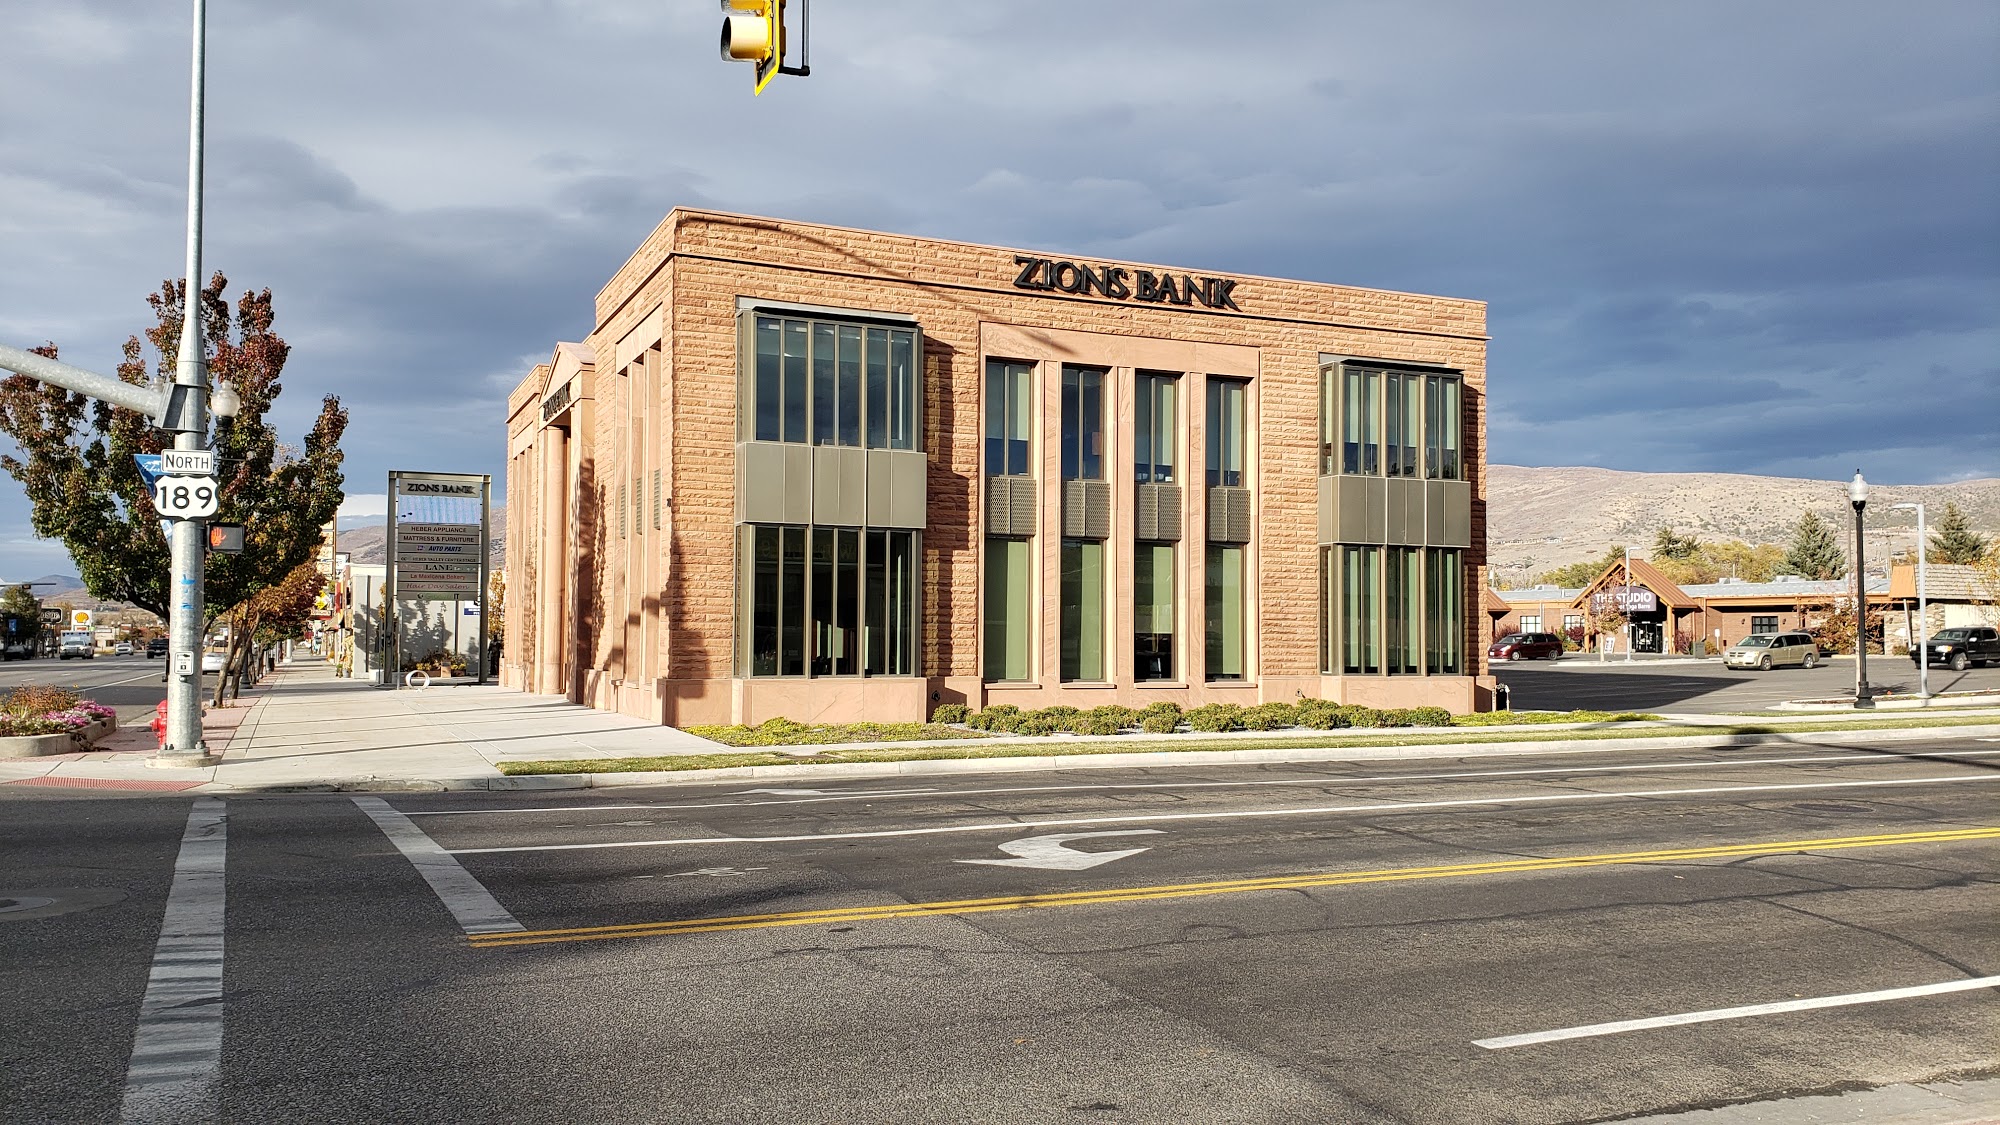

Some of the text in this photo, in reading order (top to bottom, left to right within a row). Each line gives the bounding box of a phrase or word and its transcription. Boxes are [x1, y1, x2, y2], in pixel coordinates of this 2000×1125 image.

[1013, 255, 1242, 312] ZIONS BANK
[165, 454, 209, 469] NORTH
[407, 483, 476, 494] ZIONS BANK
[160, 486, 212, 509] 189
[1594, 592, 1652, 603] THE STUDIO
